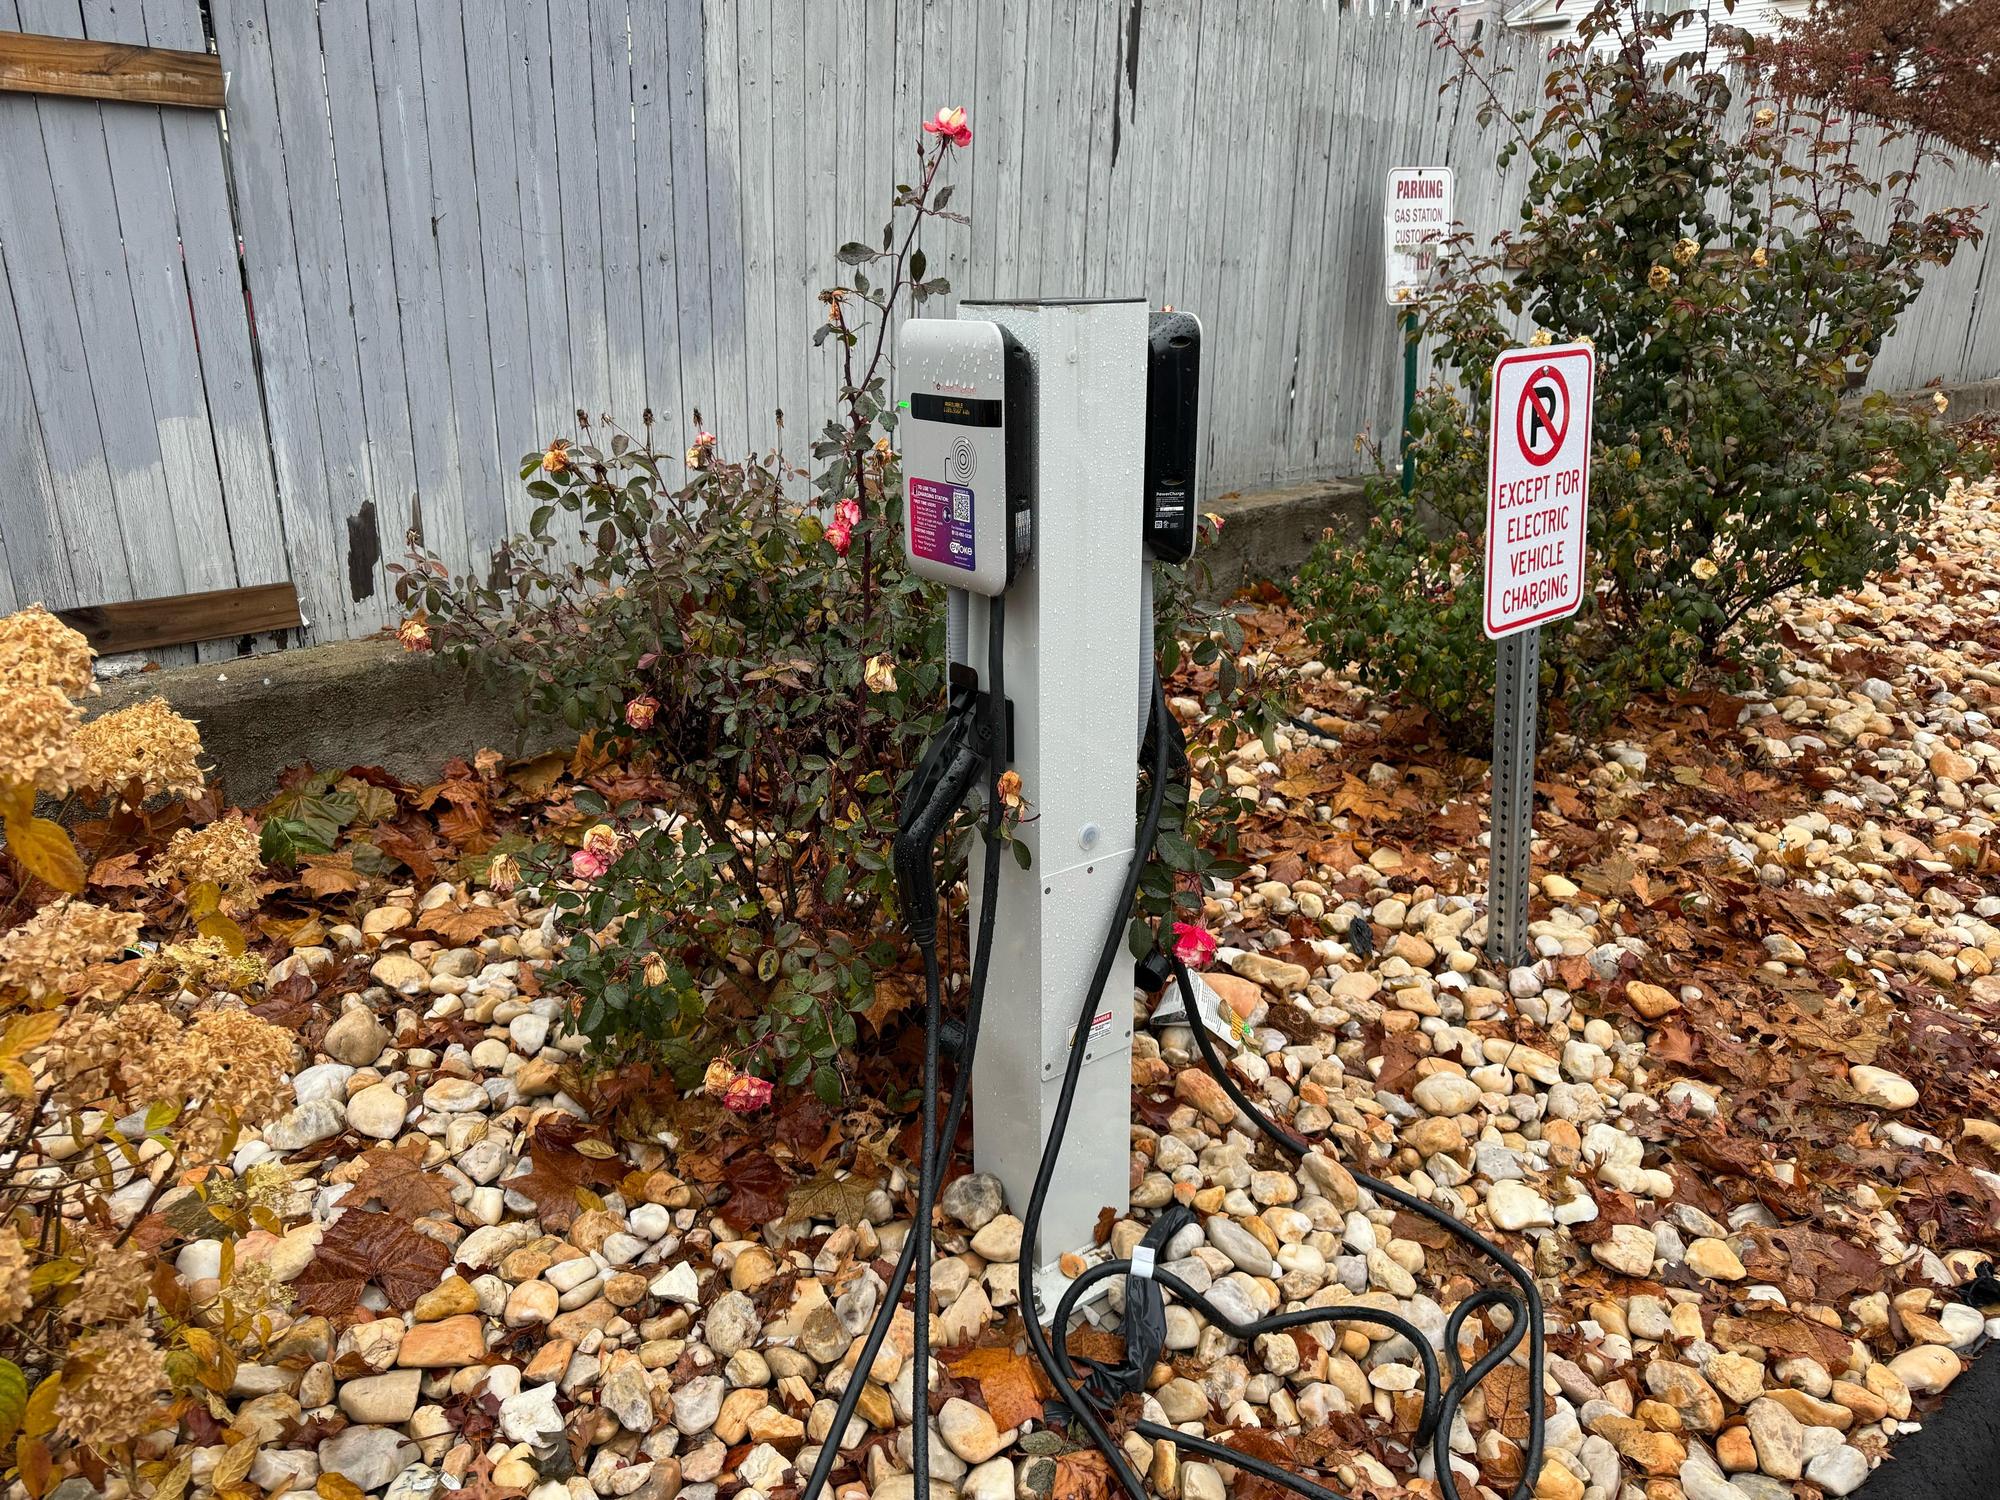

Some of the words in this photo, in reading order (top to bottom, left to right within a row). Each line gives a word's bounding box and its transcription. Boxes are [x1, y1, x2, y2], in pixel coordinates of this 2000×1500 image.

[1397, 180, 1443, 199] PARKING
[1395, 208, 1411, 223] GAS
[1412, 207, 1443, 222] STATION
[1498, 474, 1550, 510] EXCEPT
[1555, 469, 1580, 498] FOR
[1507, 506, 1569, 544] ELECTRIC
[1510, 540, 1564, 577] VEHICLE
[1502, 573, 1568, 614] CHARGING
